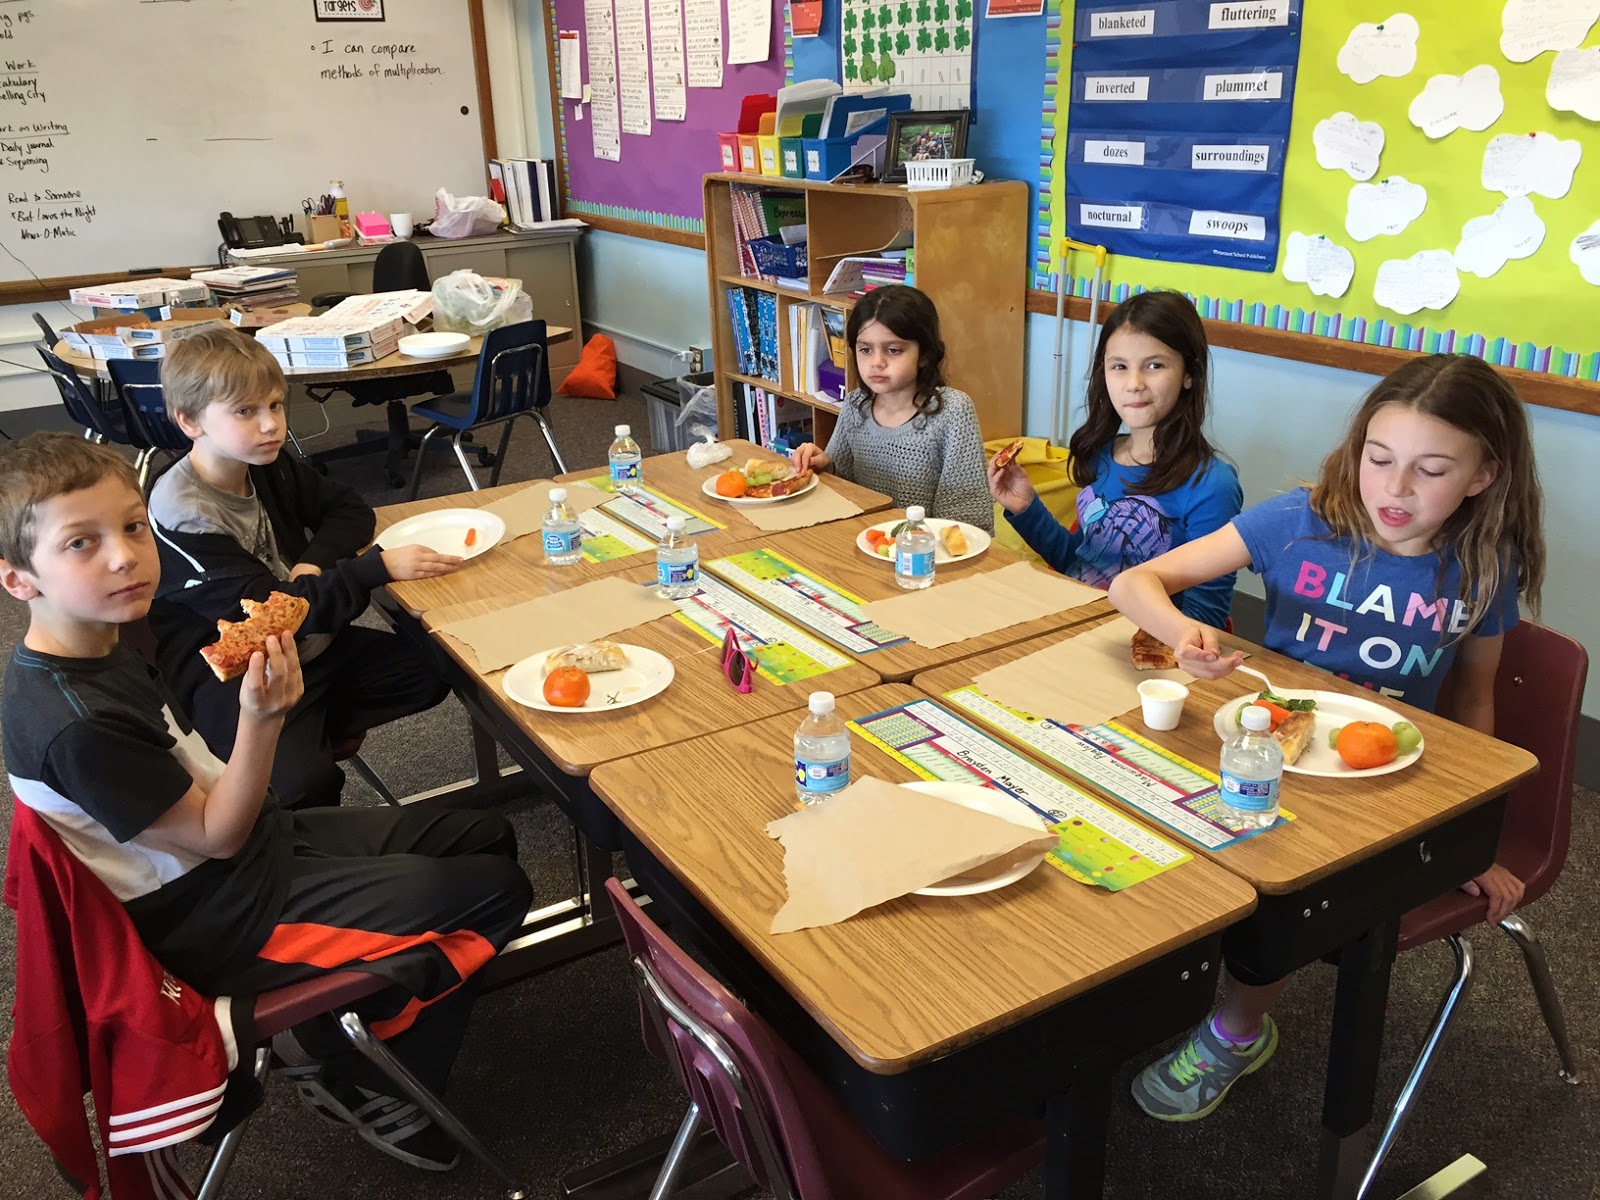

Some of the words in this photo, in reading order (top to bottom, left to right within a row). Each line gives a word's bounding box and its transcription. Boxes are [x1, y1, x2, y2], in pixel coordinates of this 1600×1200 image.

[323, 0, 357, 12] Targets
[1221, 6, 1277, 22] fluttering
[1098, 15, 1146, 30] blanketed
[322, 40, 334, 54] I
[344, 44, 364, 54] can
[371, 44, 416, 59] compare
[5, 60, 37, 71] Work
[320, 64, 363, 80] methods
[369, 63, 381, 77] of
[1095, 81, 1135, 94] inverted
[1215, 78, 1268, 96] plummet
[0, 90, 27, 106] elling
[27, 90, 45, 103] City
[33, 121, 69, 136] Writing
[1103, 145, 1128, 158] dozes
[1195, 150, 1265, 165] surroundings
[8, 192, 29, 204] Read
[33, 193, 41, 202] to
[44, 189, 81, 201] Someone
[60, 209, 73, 220] the
[74, 204, 96, 223] Night
[1087, 210, 1132, 223] nocturnal
[1206, 218, 1248, 233] swoops
[1293, 560, 1475, 634] BLAME
[1296, 612, 1348, 652] IT
[1359, 636, 1444, 677] ON
[956, 749, 993, 775] Brayden
[996, 775, 1030, 796] Mayer
